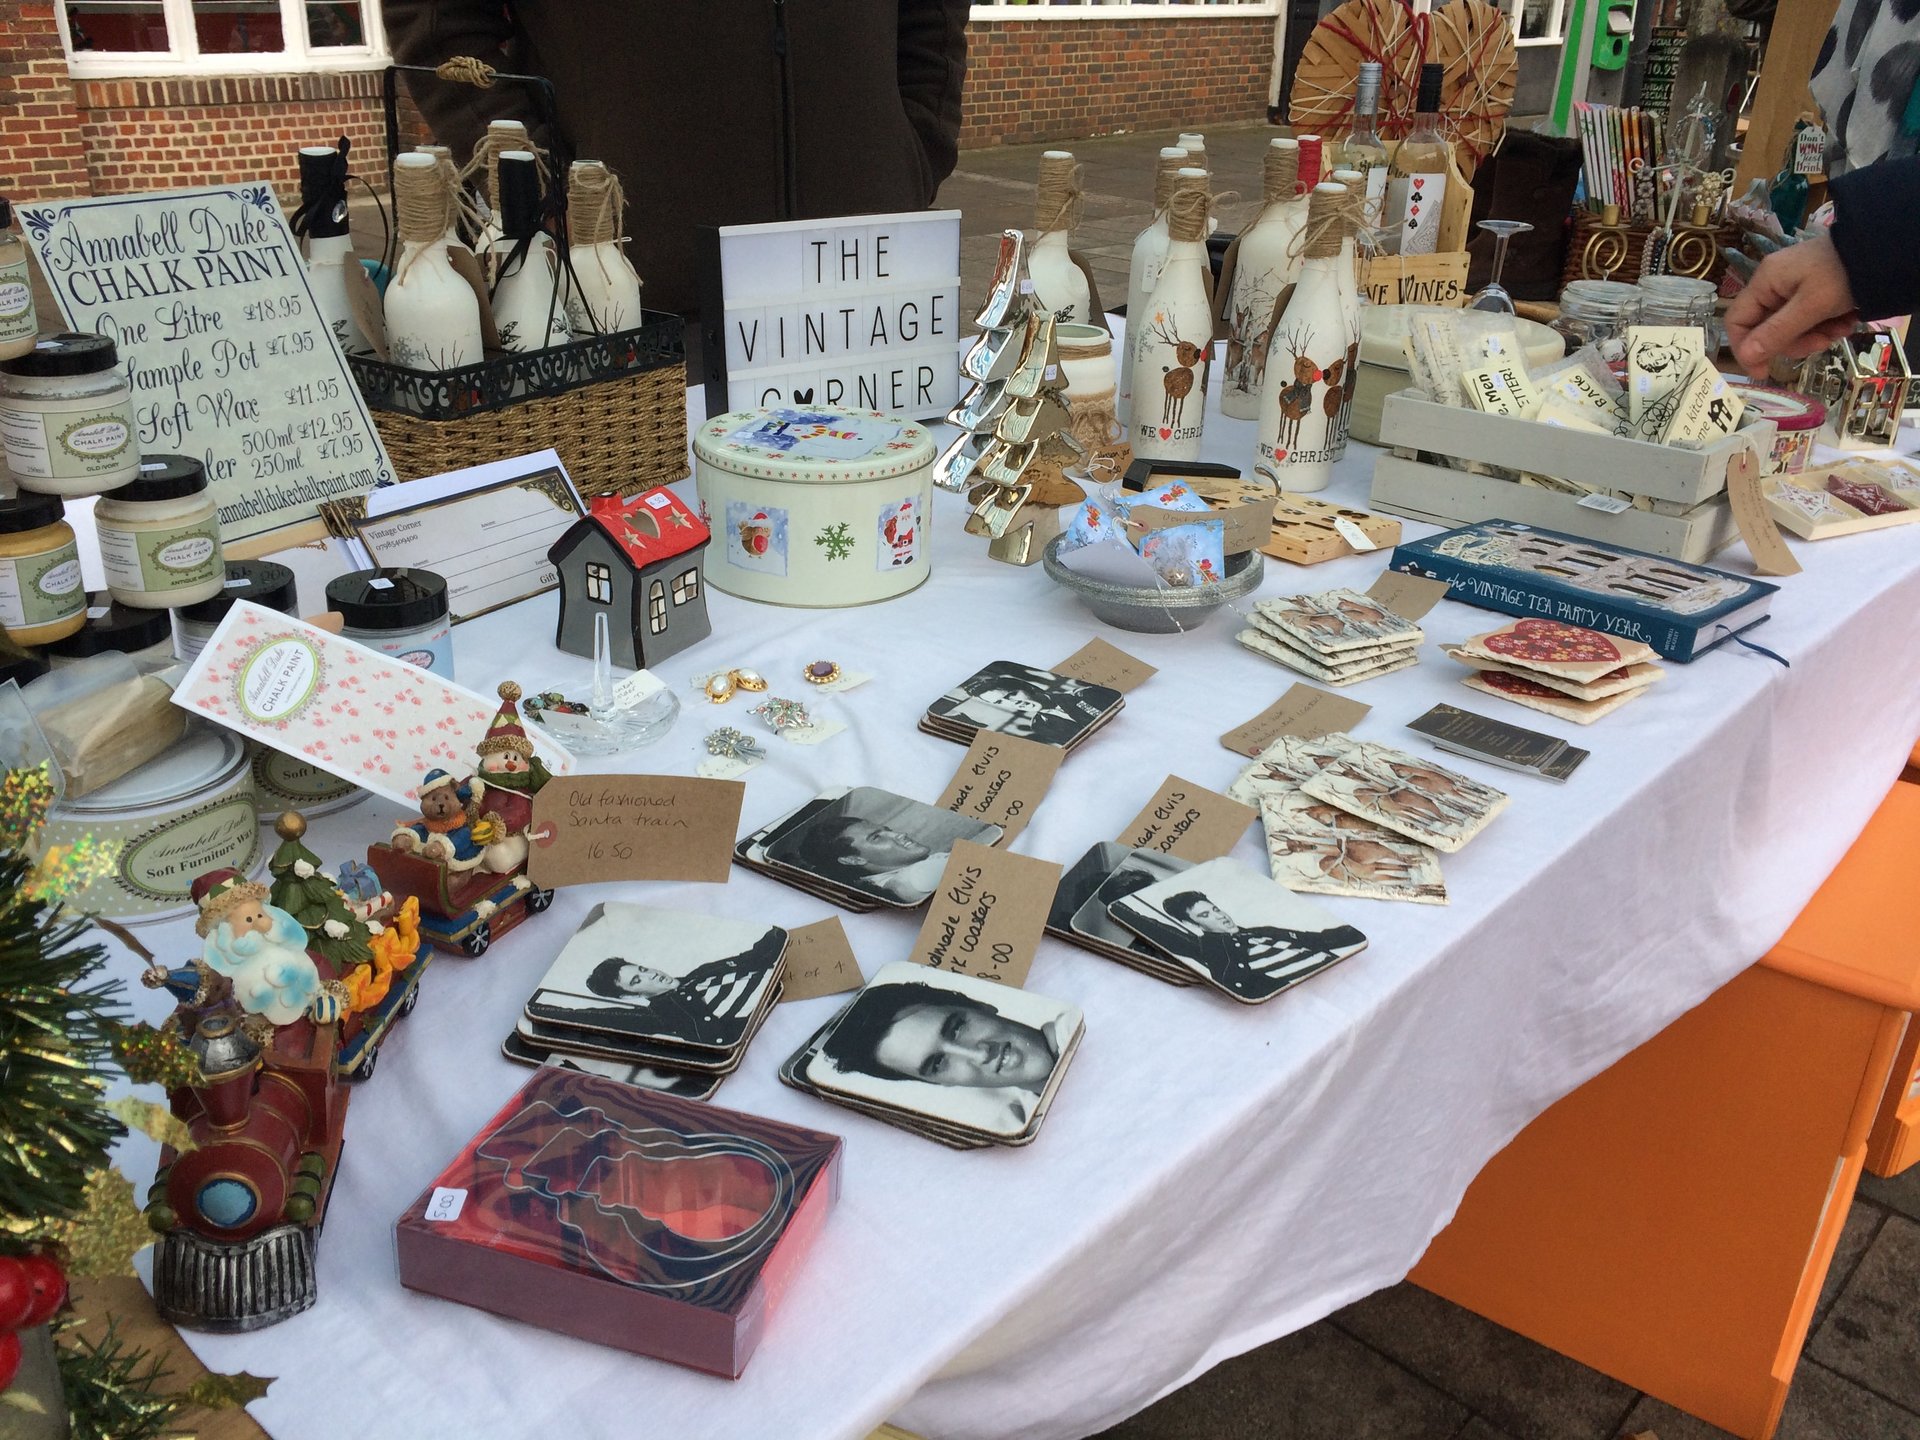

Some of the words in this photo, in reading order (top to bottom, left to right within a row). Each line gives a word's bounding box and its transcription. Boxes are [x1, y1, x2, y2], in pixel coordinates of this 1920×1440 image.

[54, 211, 187, 272] Annabell
[189, 204, 269, 255] Duke
[811, 236, 889, 283] THE
[68, 258, 197, 307] CHALK
[193, 245, 291, 288] PAINT
[0, 329, 15, 337] WEET
[95, 312, 149, 348] One
[155, 300, 224, 342] Litre
[243, 295, 302, 323] £18.95
[739, 295, 944, 362] VINTAGE
[211, 337, 260, 380] Pot
[266, 330, 314, 357] £7.95
[1478, 373, 1501, 404] Men
[1574, 374, 1607, 408] BACK
[1686, 378, 1712, 424] kitchen
[137, 401, 194, 449] Soft
[197, 388, 260, 428] Wax
[284, 377, 340, 406] £11.95
[242, 423, 296, 457] 500ml
[299, 411, 354, 441] £12.95
[1140, 426, 1157, 439] WE
[1696, 420, 1711, 441] me
[251, 452, 305, 481] 250ml
[317, 431, 364, 461] £7.95
[1260, 442, 1274, 459] WE
[368, 526, 397, 541] Vintage
[397, 520, 422, 532] Corner
[539, 572, 557, 584] Gift
[1446, 573, 1466, 592] the
[1467, 577, 1525, 607] VINTAGE
[1528, 594, 1553, 615] TEA
[1557, 600, 1601, 627] PARTY
[1605, 614, 1652, 643] YEAR
[262, 679, 288, 712] CHALK
[283, 648, 304, 678] PAINT
[569, 789, 592, 807] Old
[569, 810, 624, 828] Santa
[636, 812, 690, 829] train
[146, 865, 175, 879] Soft
[180, 842, 236, 872] Furniture
[236, 829, 253, 844] Wax
